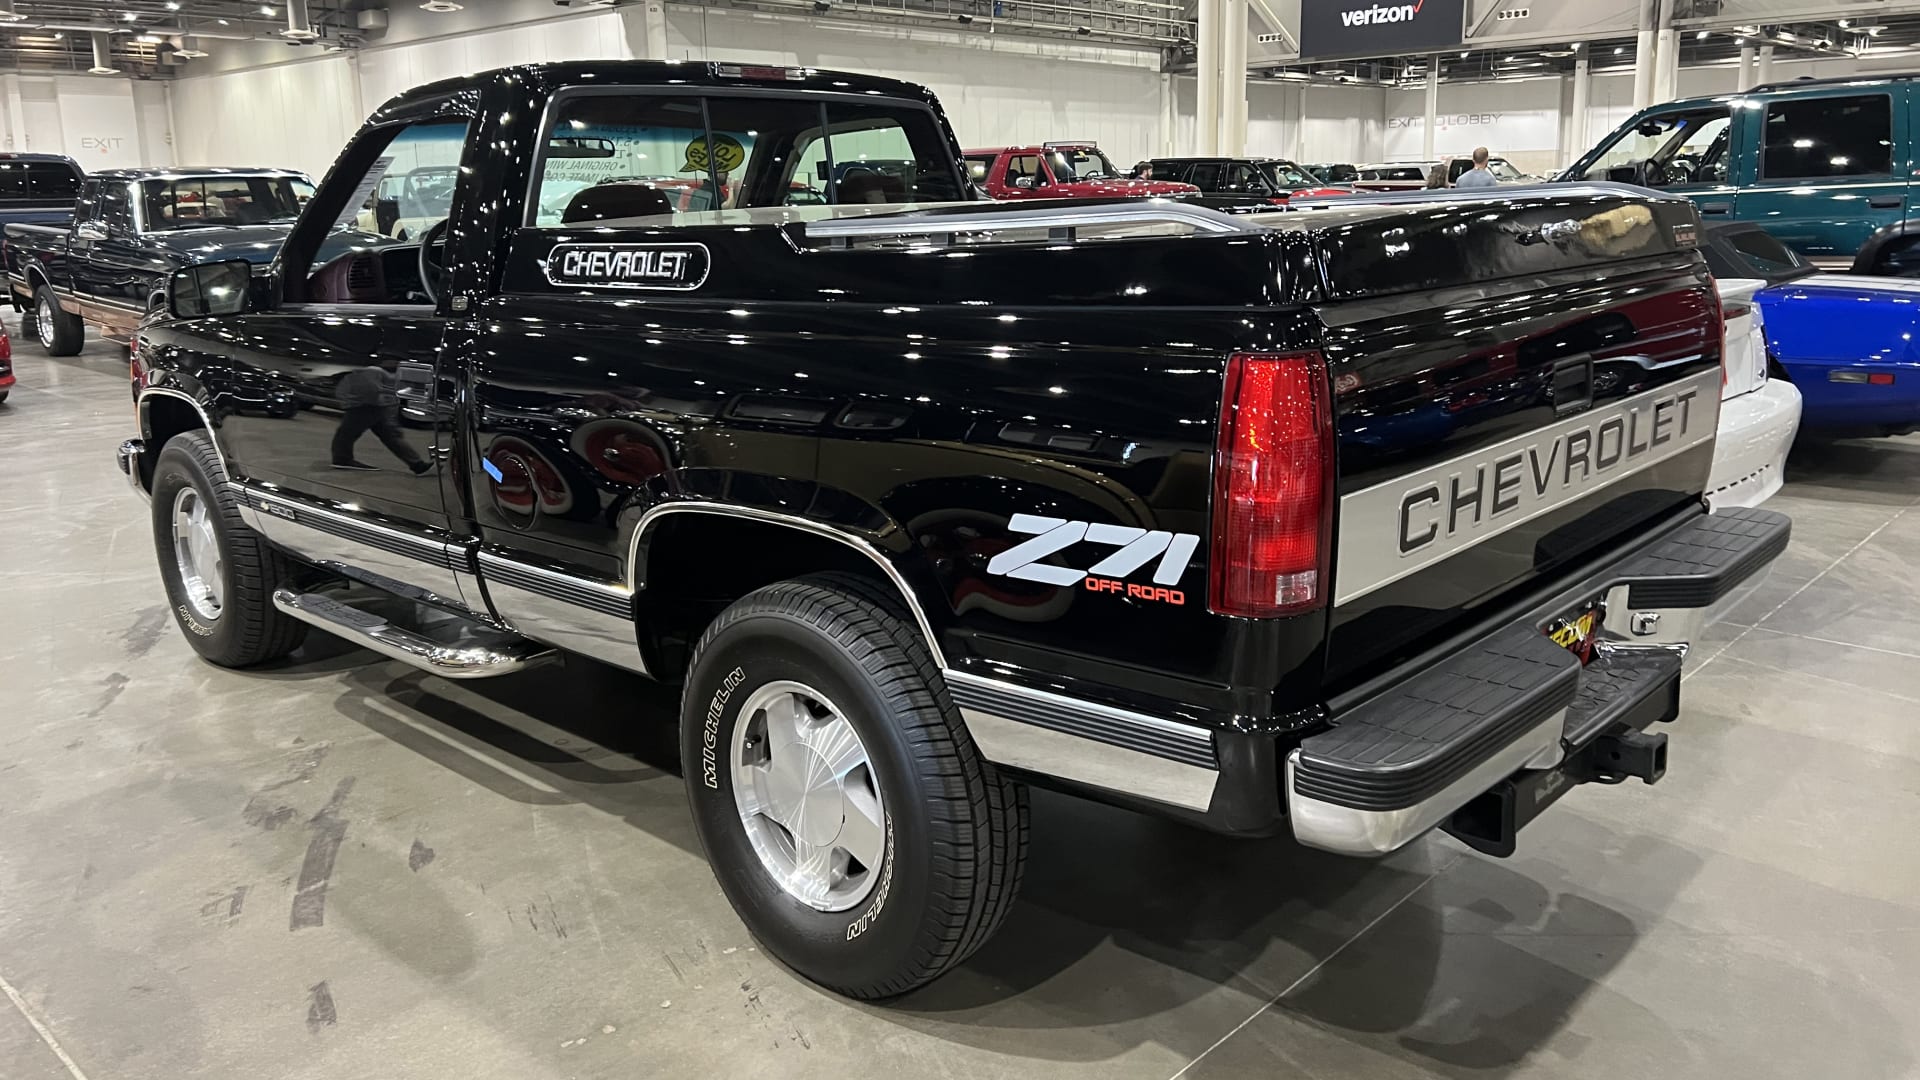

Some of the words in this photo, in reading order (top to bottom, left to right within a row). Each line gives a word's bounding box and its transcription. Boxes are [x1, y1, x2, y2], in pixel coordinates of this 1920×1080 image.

[1341, 4, 1414, 27] verizon
[1388, 116, 1420, 128] EXIT
[1447, 113, 1503, 126] LOBBY
[81, 137, 123, 149] EXIT
[563, 251, 688, 280] CHEVROLET
[1398, 388, 1698, 556] CHEVROLET
[987, 513, 1200, 587] Z71
[1085, 577, 1123, 593] OFF
[1127, 583, 1185, 605] ROAD
[703, 666, 746, 789] MICHELIN
[846, 810, 894, 941] MICHELIN
